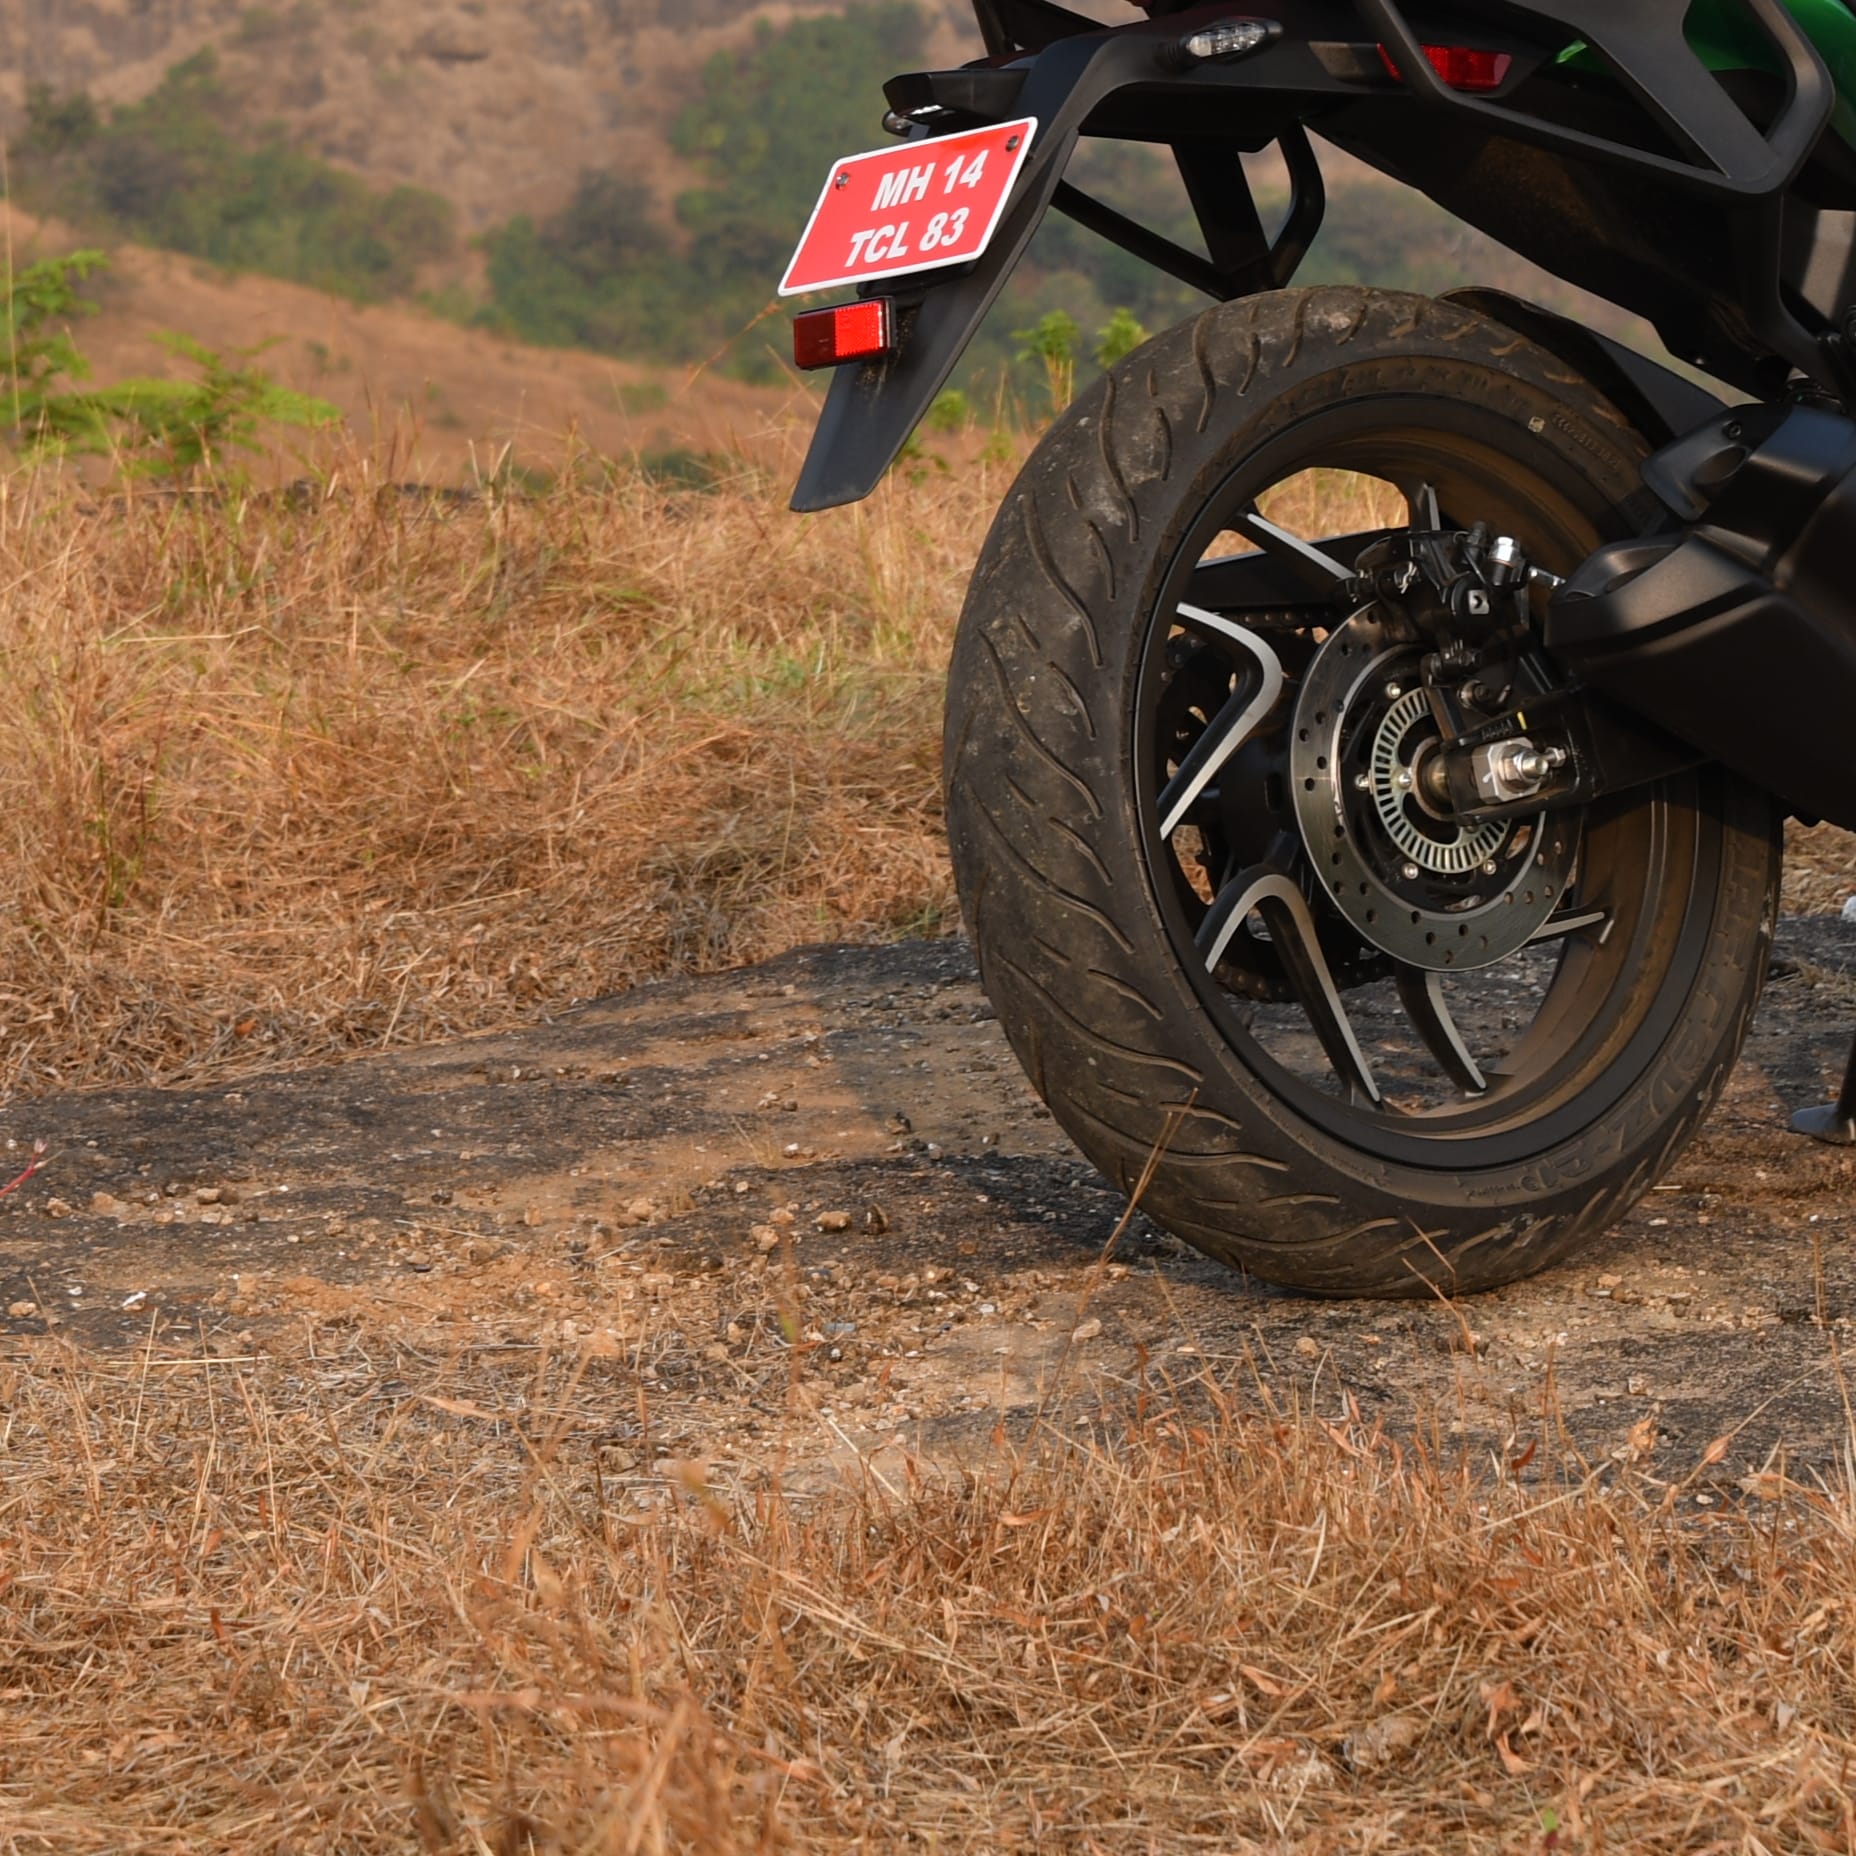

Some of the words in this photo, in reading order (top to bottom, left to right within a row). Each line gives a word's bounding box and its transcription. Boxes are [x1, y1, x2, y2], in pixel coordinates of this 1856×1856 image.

[870, 162, 936, 212] MH
[943, 149, 989, 194] 14
[844, 221, 910, 268] TCL
[918, 207, 970, 251] 83
